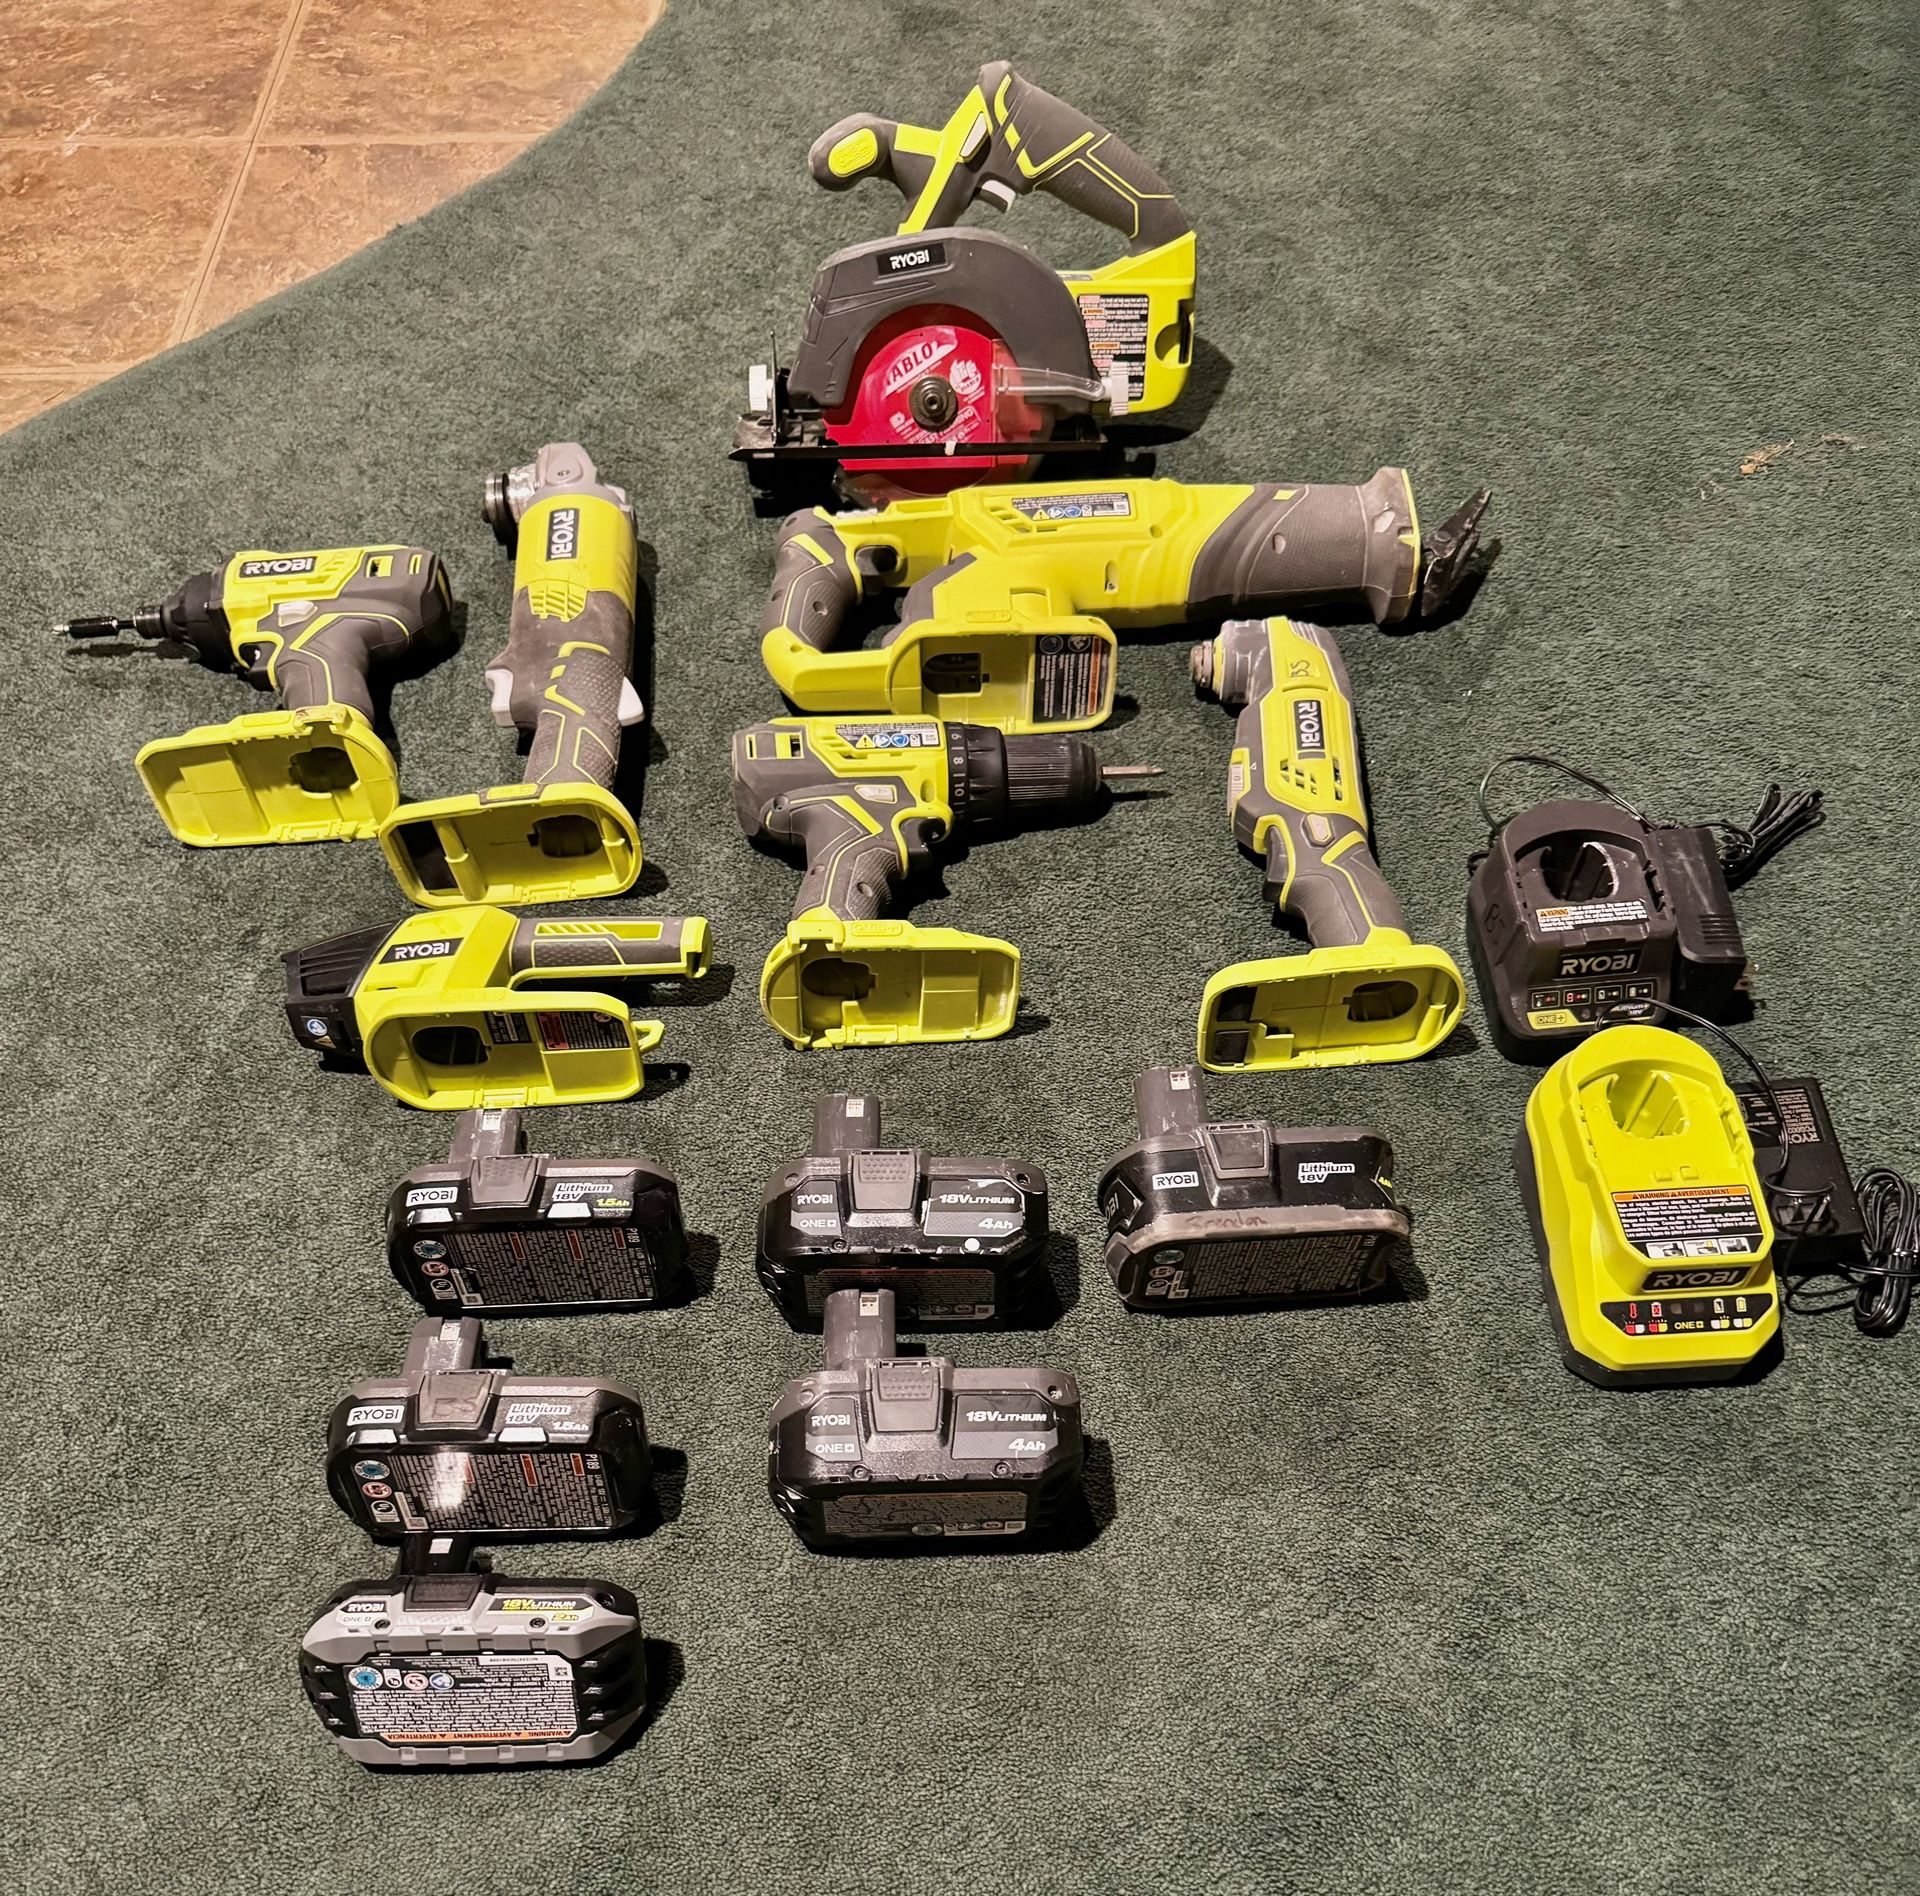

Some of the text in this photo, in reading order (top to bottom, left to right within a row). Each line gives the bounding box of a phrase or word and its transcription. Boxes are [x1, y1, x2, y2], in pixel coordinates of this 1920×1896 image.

[889, 248, 930, 270] RYOBI
[550, 509, 575, 559] RYOBI
[245, 557, 313, 575] RYOBI
[1297, 701, 1321, 748] RYOBI
[953, 756, 964, 765] 8
[954, 782, 965, 797] 10
[395, 941, 450, 960] RYOBI
[1560, 953, 1635, 976] RYOBI
[1537, 1012, 1567, 1025] ONE+
[1301, 1162, 1353, 1173] Lithium
[1157, 1175, 1196, 1186] RYOBI
[1301, 1174, 1325, 1183] 18V
[557, 1183, 611, 1193] Lithium
[1677, 1188, 1730, 1197] AVERTISSEMENT
[410, 1190, 454, 1203] RYOBI
[797, 1194, 834, 1205] RYOBI
[978, 1217, 1013, 1230] 4Ah
[1652, 1270, 1739, 1288] RYOBI
[351, 1408, 399, 1421] RYOBI
[511, 1403, 568, 1413] Lithium
[811, 1415, 850, 1426] RYOBI
[1008, 1438, 1046, 1452] 4Ah
[585, 1453, 600, 1470] P189
[347, 1602, 384, 1612] RYOBI
